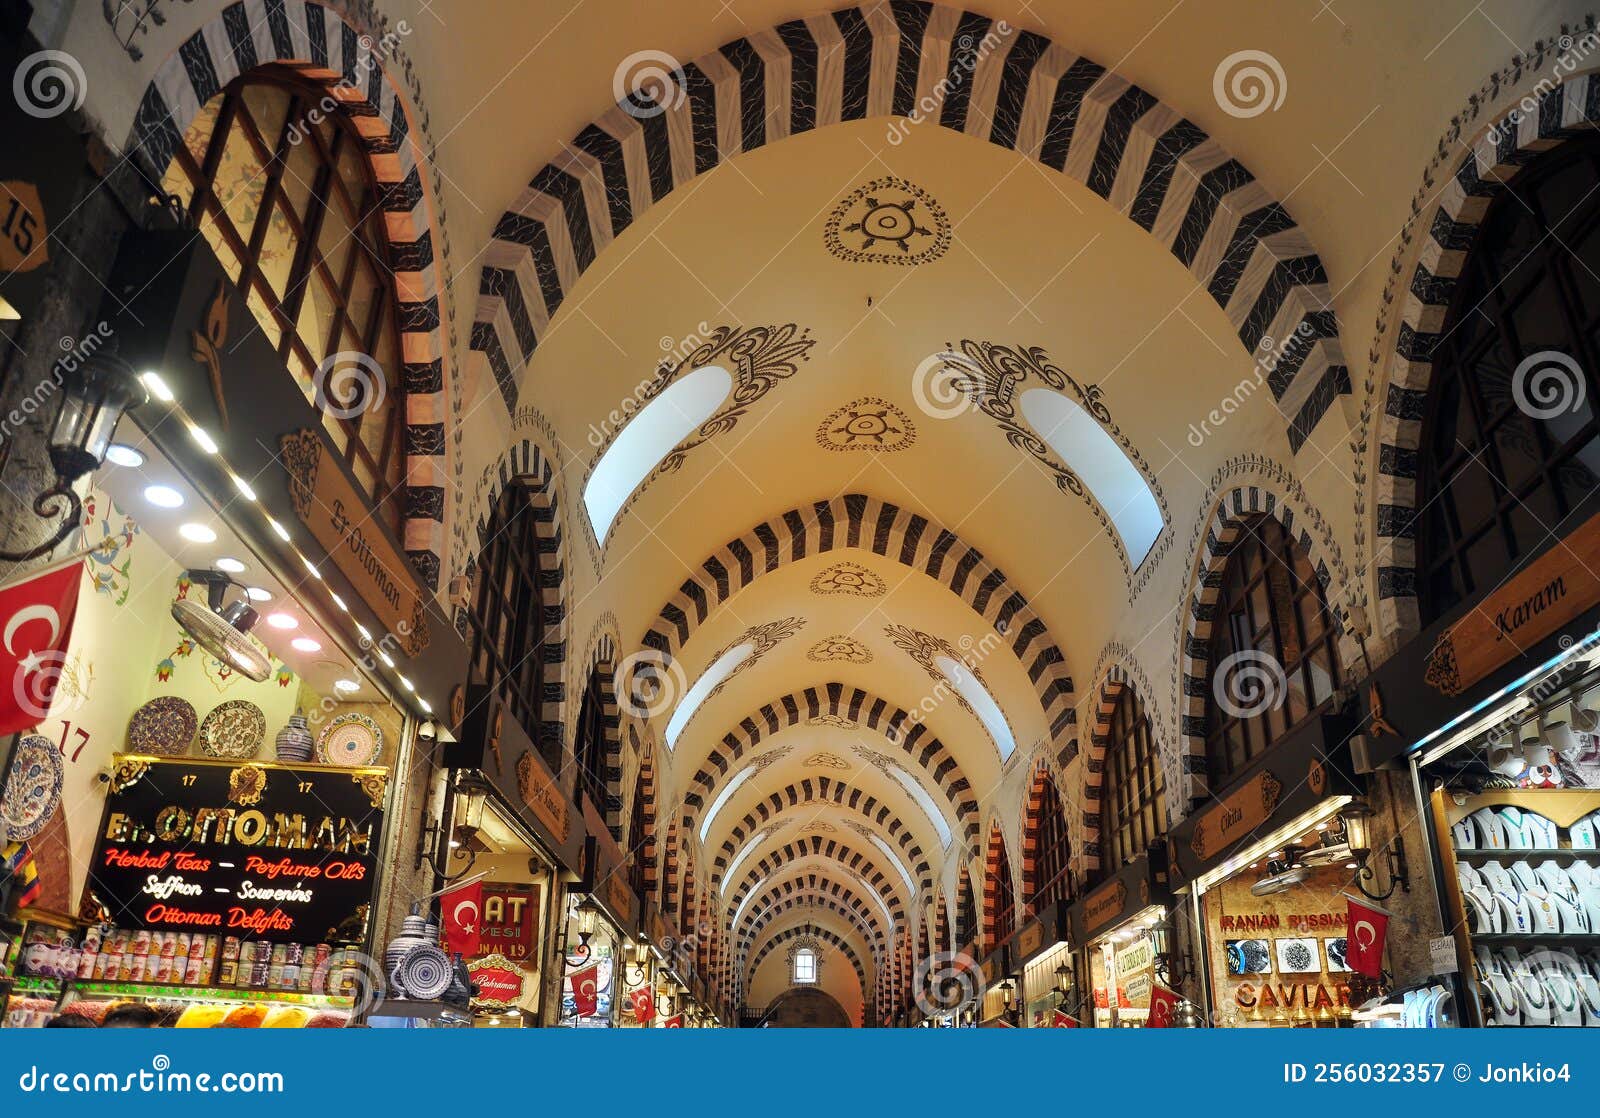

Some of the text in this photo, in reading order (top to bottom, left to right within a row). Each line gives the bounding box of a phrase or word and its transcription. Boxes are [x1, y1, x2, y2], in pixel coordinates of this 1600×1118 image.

[2, 199, 37, 256] 15
[1496, 576, 1566, 641] Karam
[60, 720, 90, 763] 17
[182, 775, 197, 786] 17
[298, 782, 313, 793] 17
[1312, 768, 1320, 786] 18
[105, 848, 366, 880] Herbal Teas Perfume Oils
[143, 874, 313, 902] Saffron Souvenirs
[145, 903, 293, 932] Ottoman Delights
[1220, 914, 1280, 931] IRANIAN
[473, 974, 517, 990] Bahraman
[1235, 983, 1351, 1008] CAVIAR
